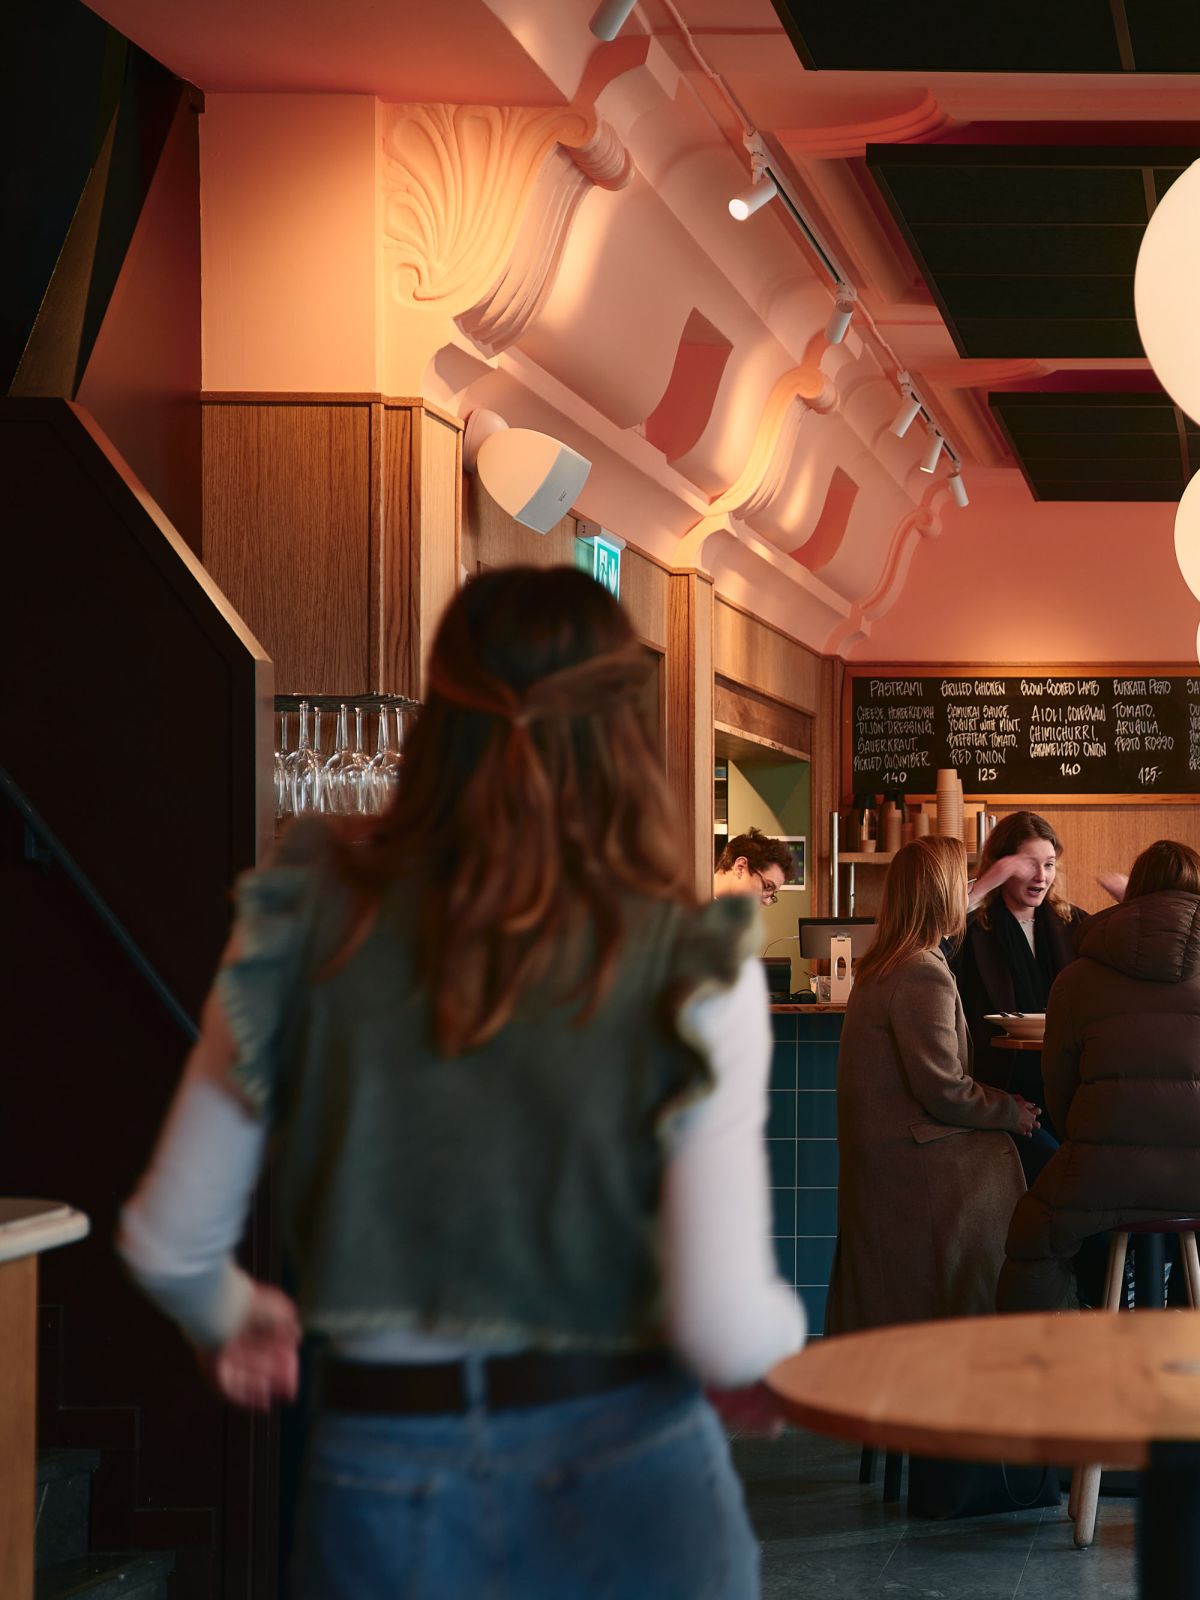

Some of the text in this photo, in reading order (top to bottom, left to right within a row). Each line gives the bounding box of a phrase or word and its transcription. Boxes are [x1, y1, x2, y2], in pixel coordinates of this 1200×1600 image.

[870, 680, 923, 697] PASTRAMI
[940, 680, 1005, 696] GRILLED CHICKEN
[1078, 681, 1100, 696] LAMB
[1113, 679, 1171, 695] BURRATA PESTO
[856, 721, 884, 735] DIJON
[948, 718, 977, 733] YOGURT
[1083, 742, 1106, 757] ONION
[1115, 736, 1174, 752] PESTO ROSSO
[884, 751, 930, 770] CUCUMBER
[950, 748, 1006, 765] RED ONION
[978, 768, 997, 781] 125
[1060, 763, 1080, 776] 140
[883, 772, 907, 783] 140
